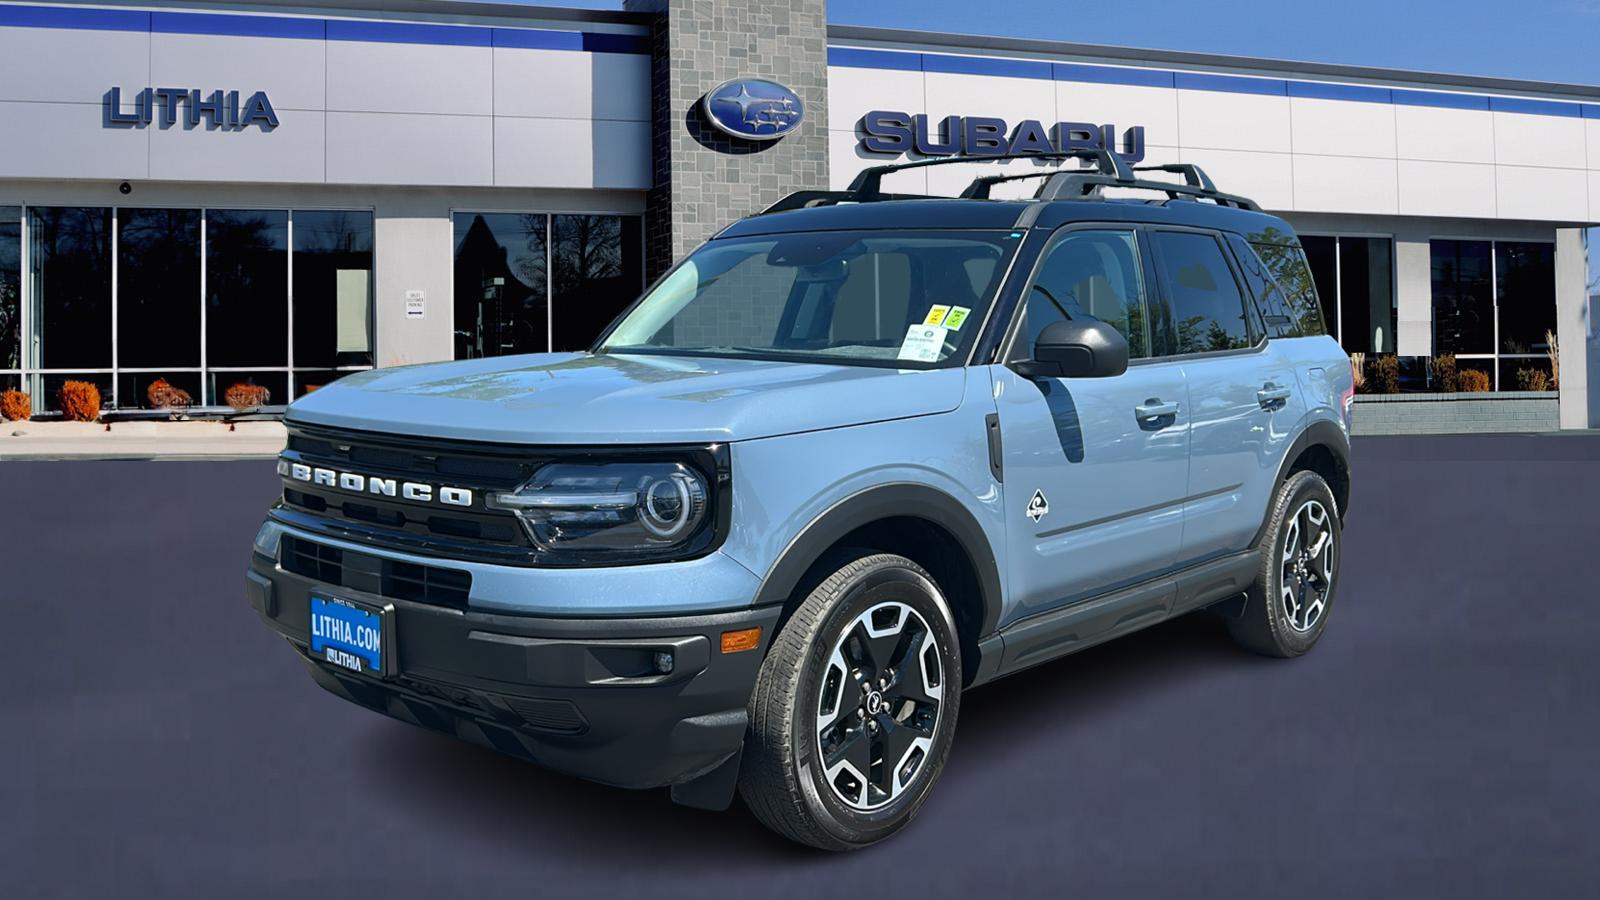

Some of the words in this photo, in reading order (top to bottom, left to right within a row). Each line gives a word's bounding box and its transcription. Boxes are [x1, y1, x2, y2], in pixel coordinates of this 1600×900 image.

[109, 86, 280, 126] LITHIA
[864, 110, 1145, 162] SUBARU
[292, 463, 472, 507] BRONCO
[312, 613, 381, 654] LITHIA.COM
[334, 650, 362, 672] LITHIA
